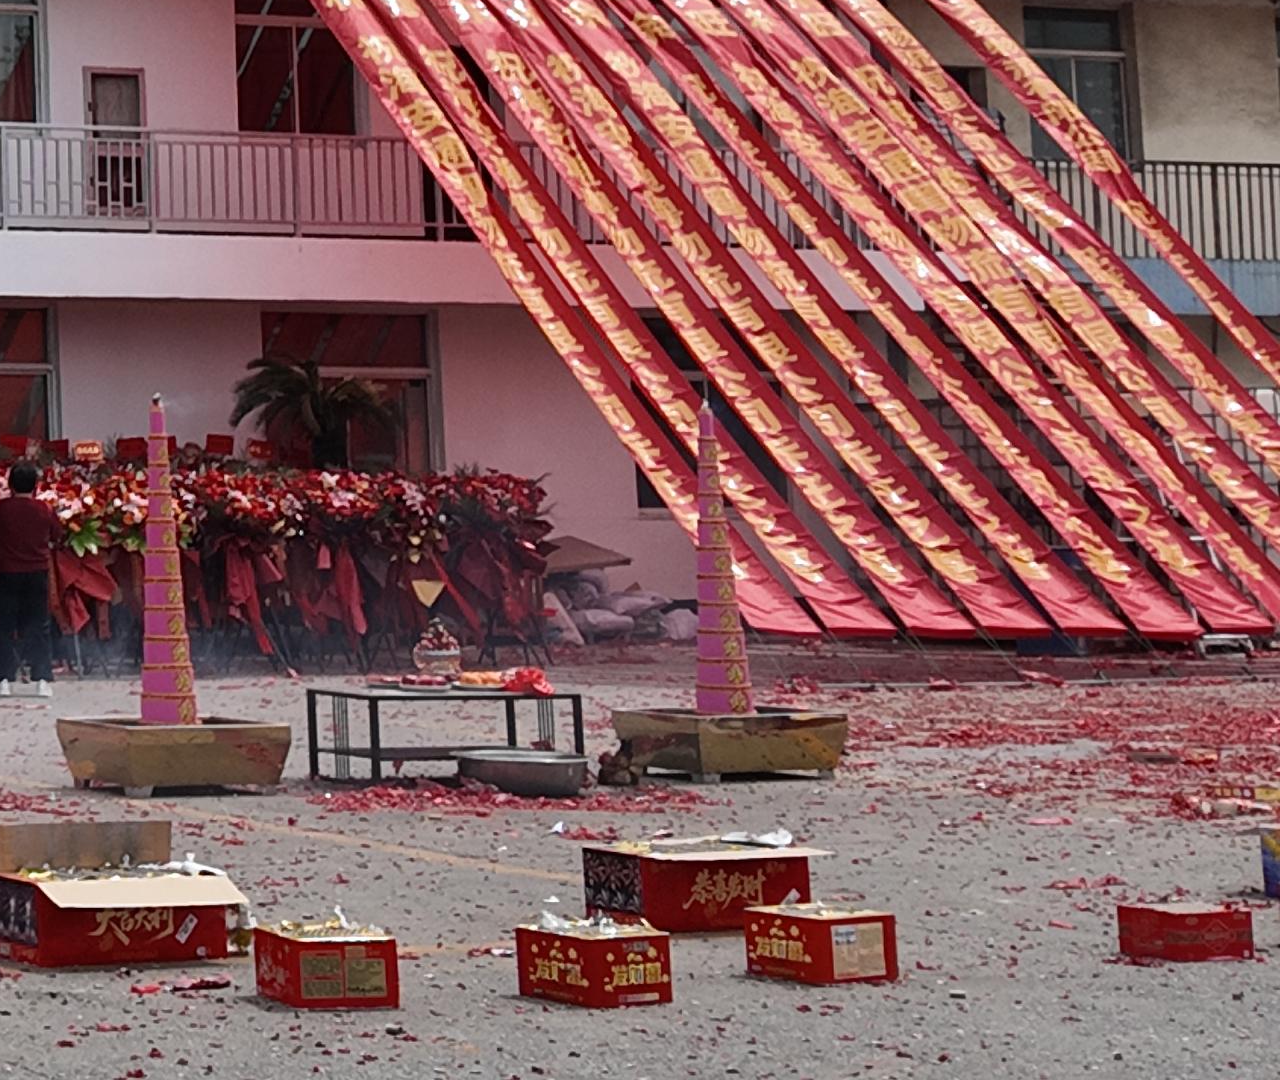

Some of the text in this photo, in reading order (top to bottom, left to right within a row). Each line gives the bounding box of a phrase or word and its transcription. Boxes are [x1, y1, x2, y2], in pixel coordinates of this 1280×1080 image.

[682, 868, 767, 911] 恭喜发财
[87, 907, 175, 947] 大吉大利
